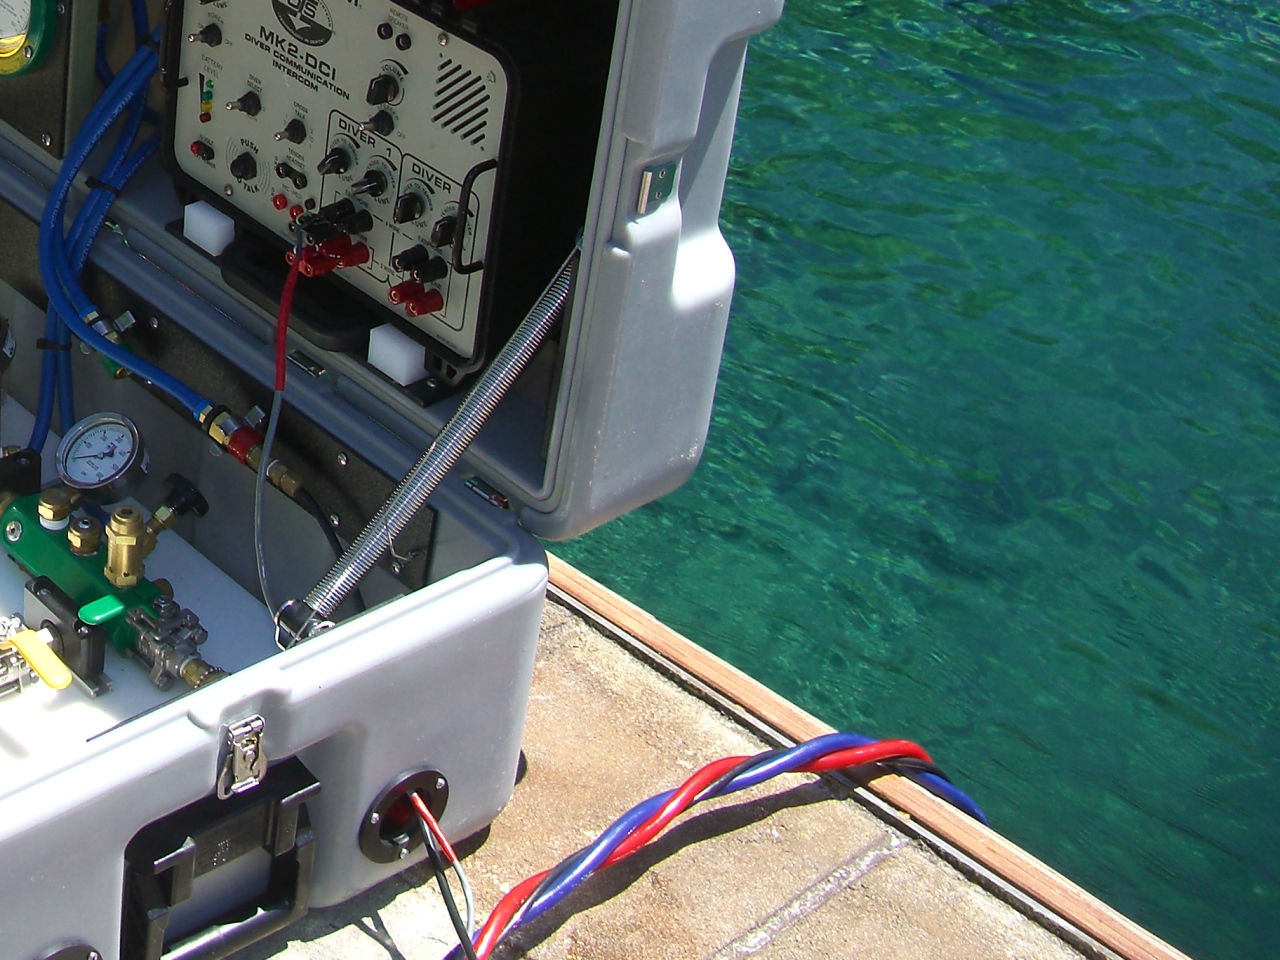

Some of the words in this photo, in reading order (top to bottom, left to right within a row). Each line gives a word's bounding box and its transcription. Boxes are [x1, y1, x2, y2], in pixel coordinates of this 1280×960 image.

[201, 54, 224, 71] BATTERY
[204, 65, 220, 79] LEVEL
[244, 32, 271, 54] DIVER
[273, 49, 350, 101] COMMUNICATION
[272, 59, 319, 92] INTERCOM
[381, 63, 404, 83] VOLUME
[240, 138, 259, 155] PUSH
[338, 117, 376, 149] DIVER
[386, 148, 392, 158] 1
[411, 161, 452, 194] DIVER
[243, 182, 260, 194] TALK
